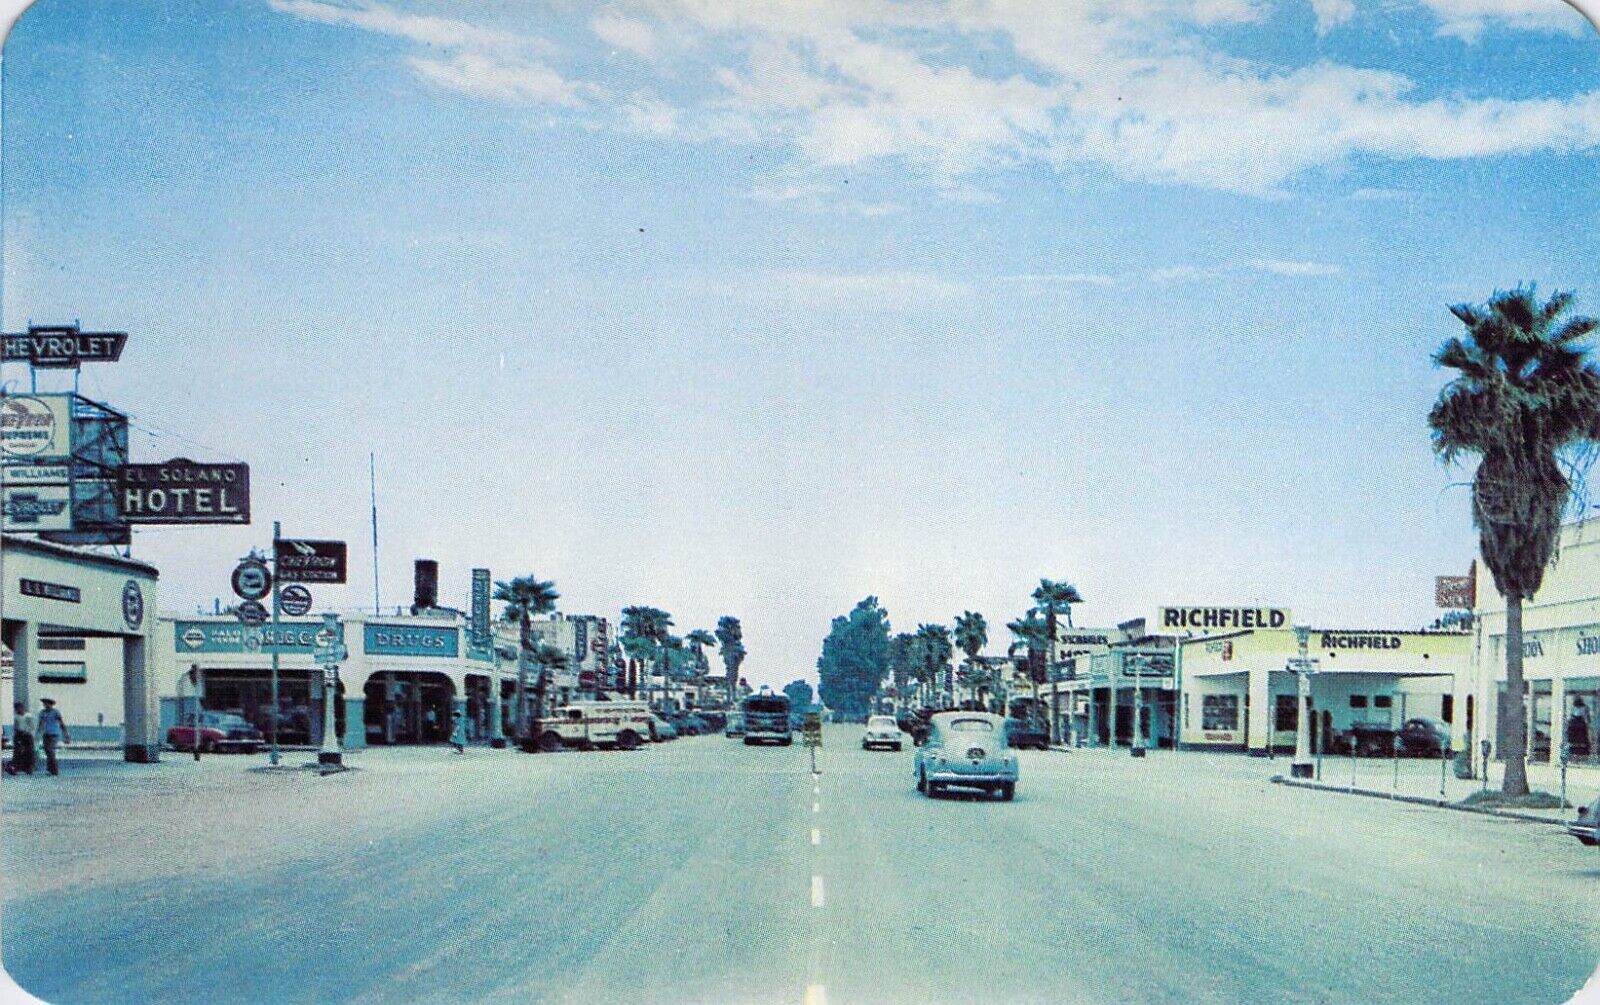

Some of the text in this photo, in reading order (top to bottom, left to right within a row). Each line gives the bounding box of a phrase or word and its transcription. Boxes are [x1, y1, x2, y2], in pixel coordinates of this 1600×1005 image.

[3, 337, 115, 355] HEVROLET
[126, 468, 236, 482] EL SOLANO
[125, 487, 238, 513] HOTEL
[1164, 608, 1285, 629] RICHFIELD
[375, 631, 445, 649] DRUGS
[1321, 632, 1402, 650] RICHFIELD
